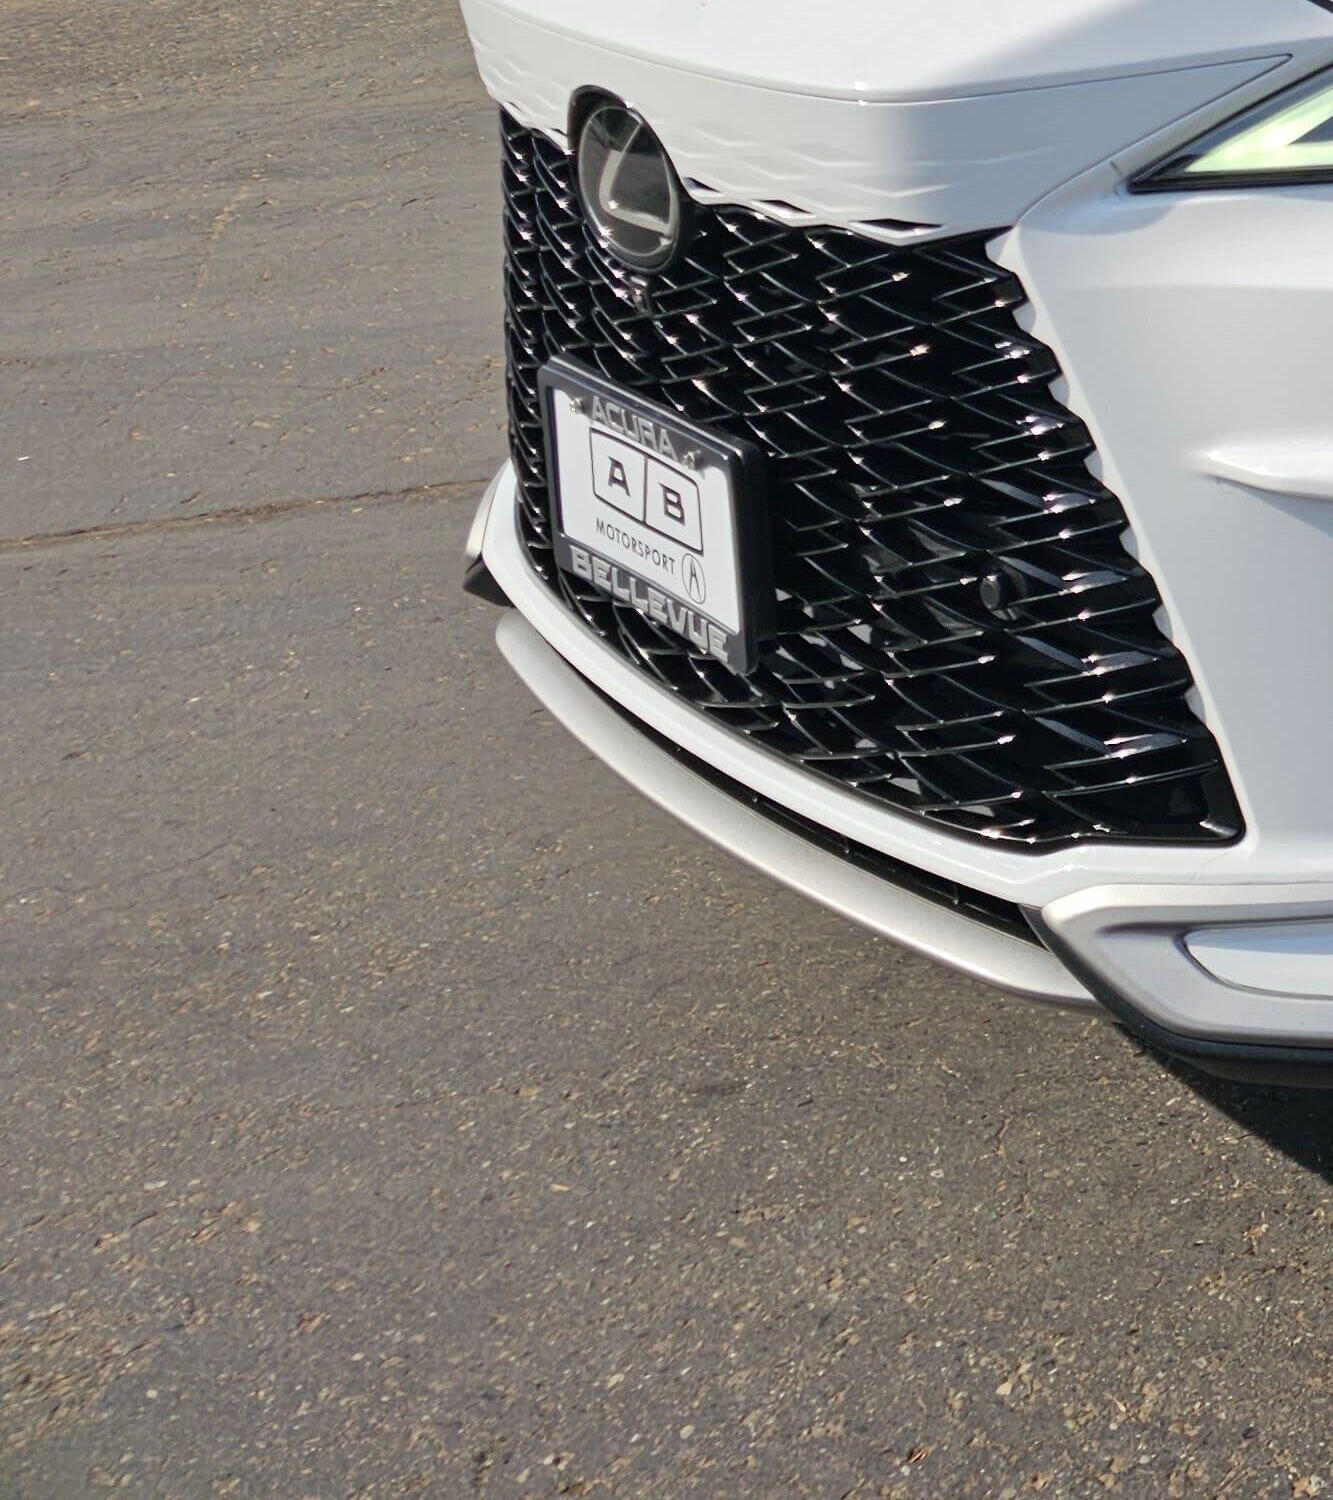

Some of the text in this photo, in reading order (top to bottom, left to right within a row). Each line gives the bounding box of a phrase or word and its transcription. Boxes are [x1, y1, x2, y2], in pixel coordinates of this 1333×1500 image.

[592, 396, 679, 462] ACURA
[607, 456, 686, 526] A B
[596, 517, 676, 576] MOTORSPORT
[570, 545, 729, 662] BELLEVUE
